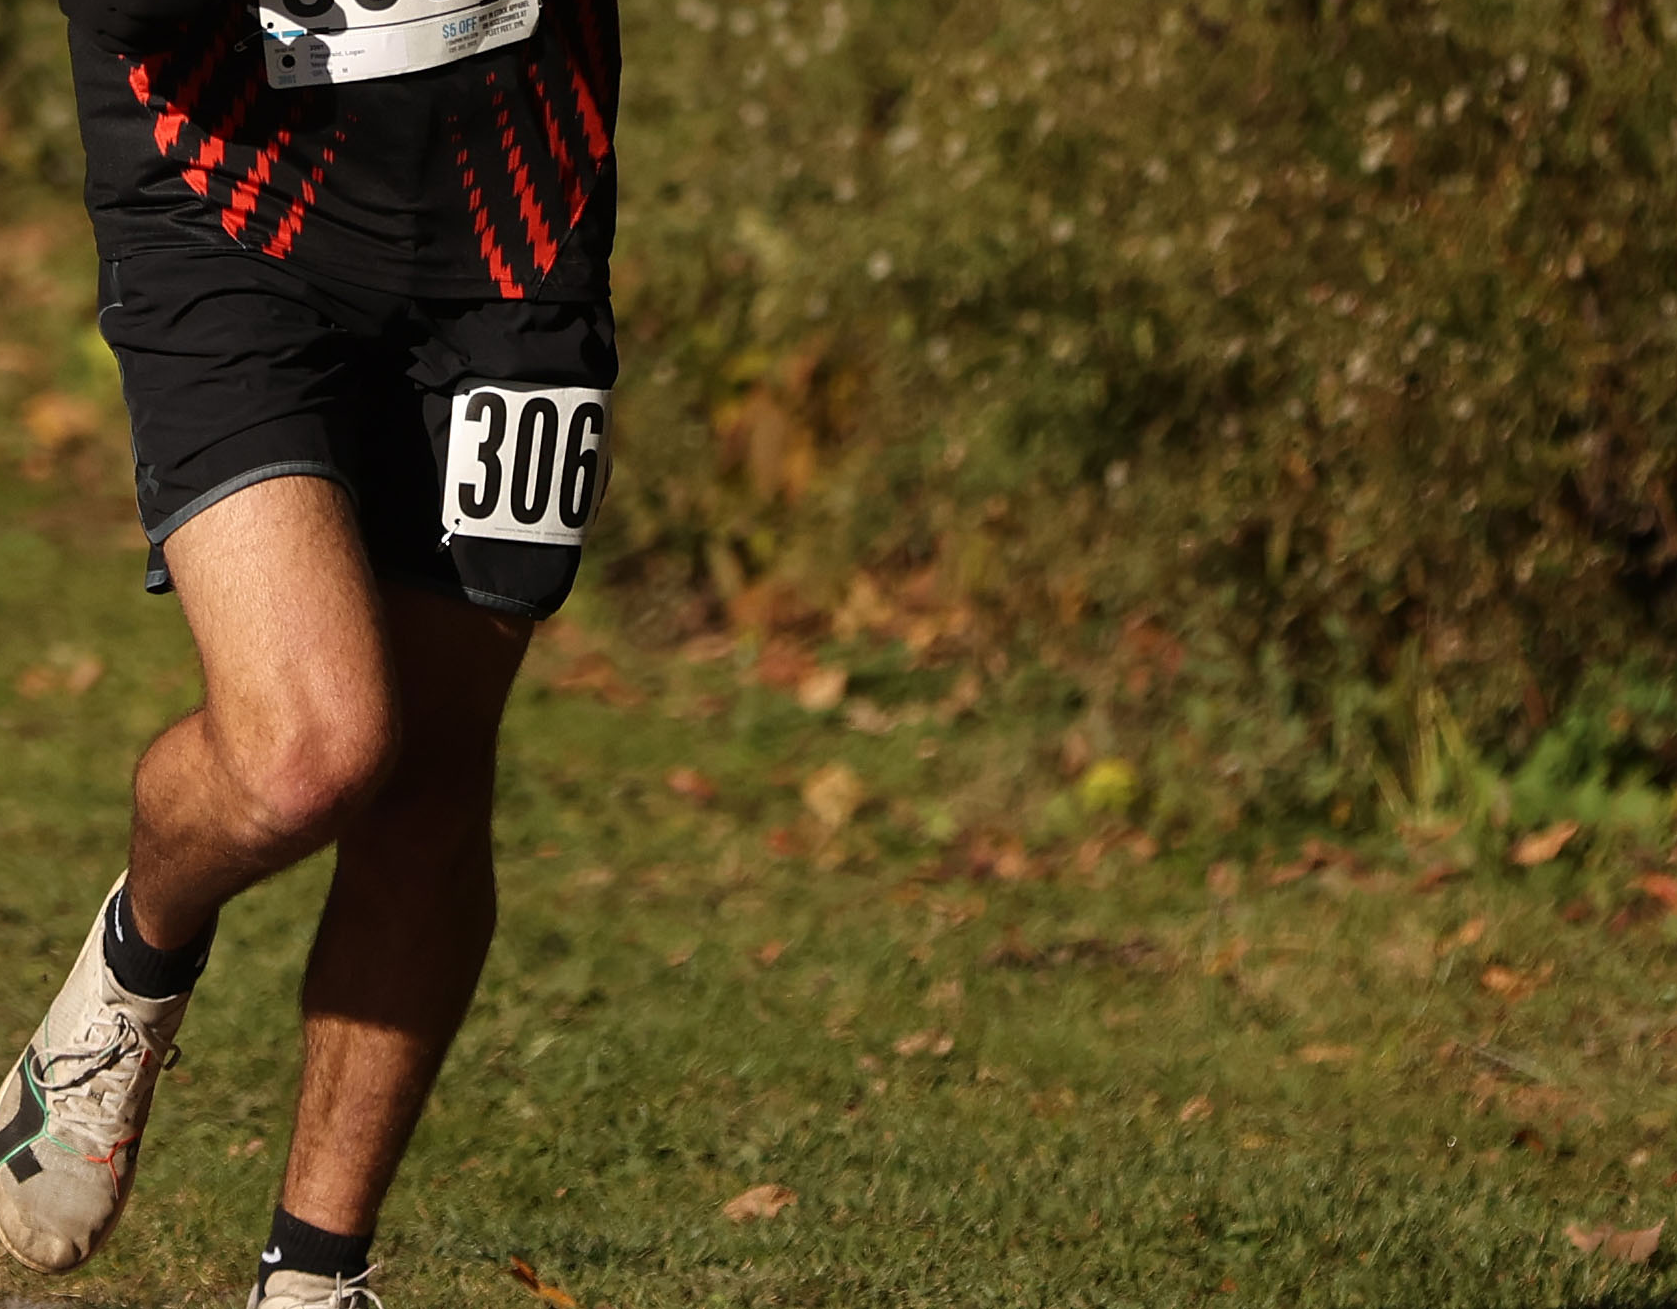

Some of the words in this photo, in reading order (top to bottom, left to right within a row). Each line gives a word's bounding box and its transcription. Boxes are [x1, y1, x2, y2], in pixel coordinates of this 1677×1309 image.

[442, 22, 457, 39] $5
[459, 16, 477, 35] OFF
[458, 391, 609, 529] 306
